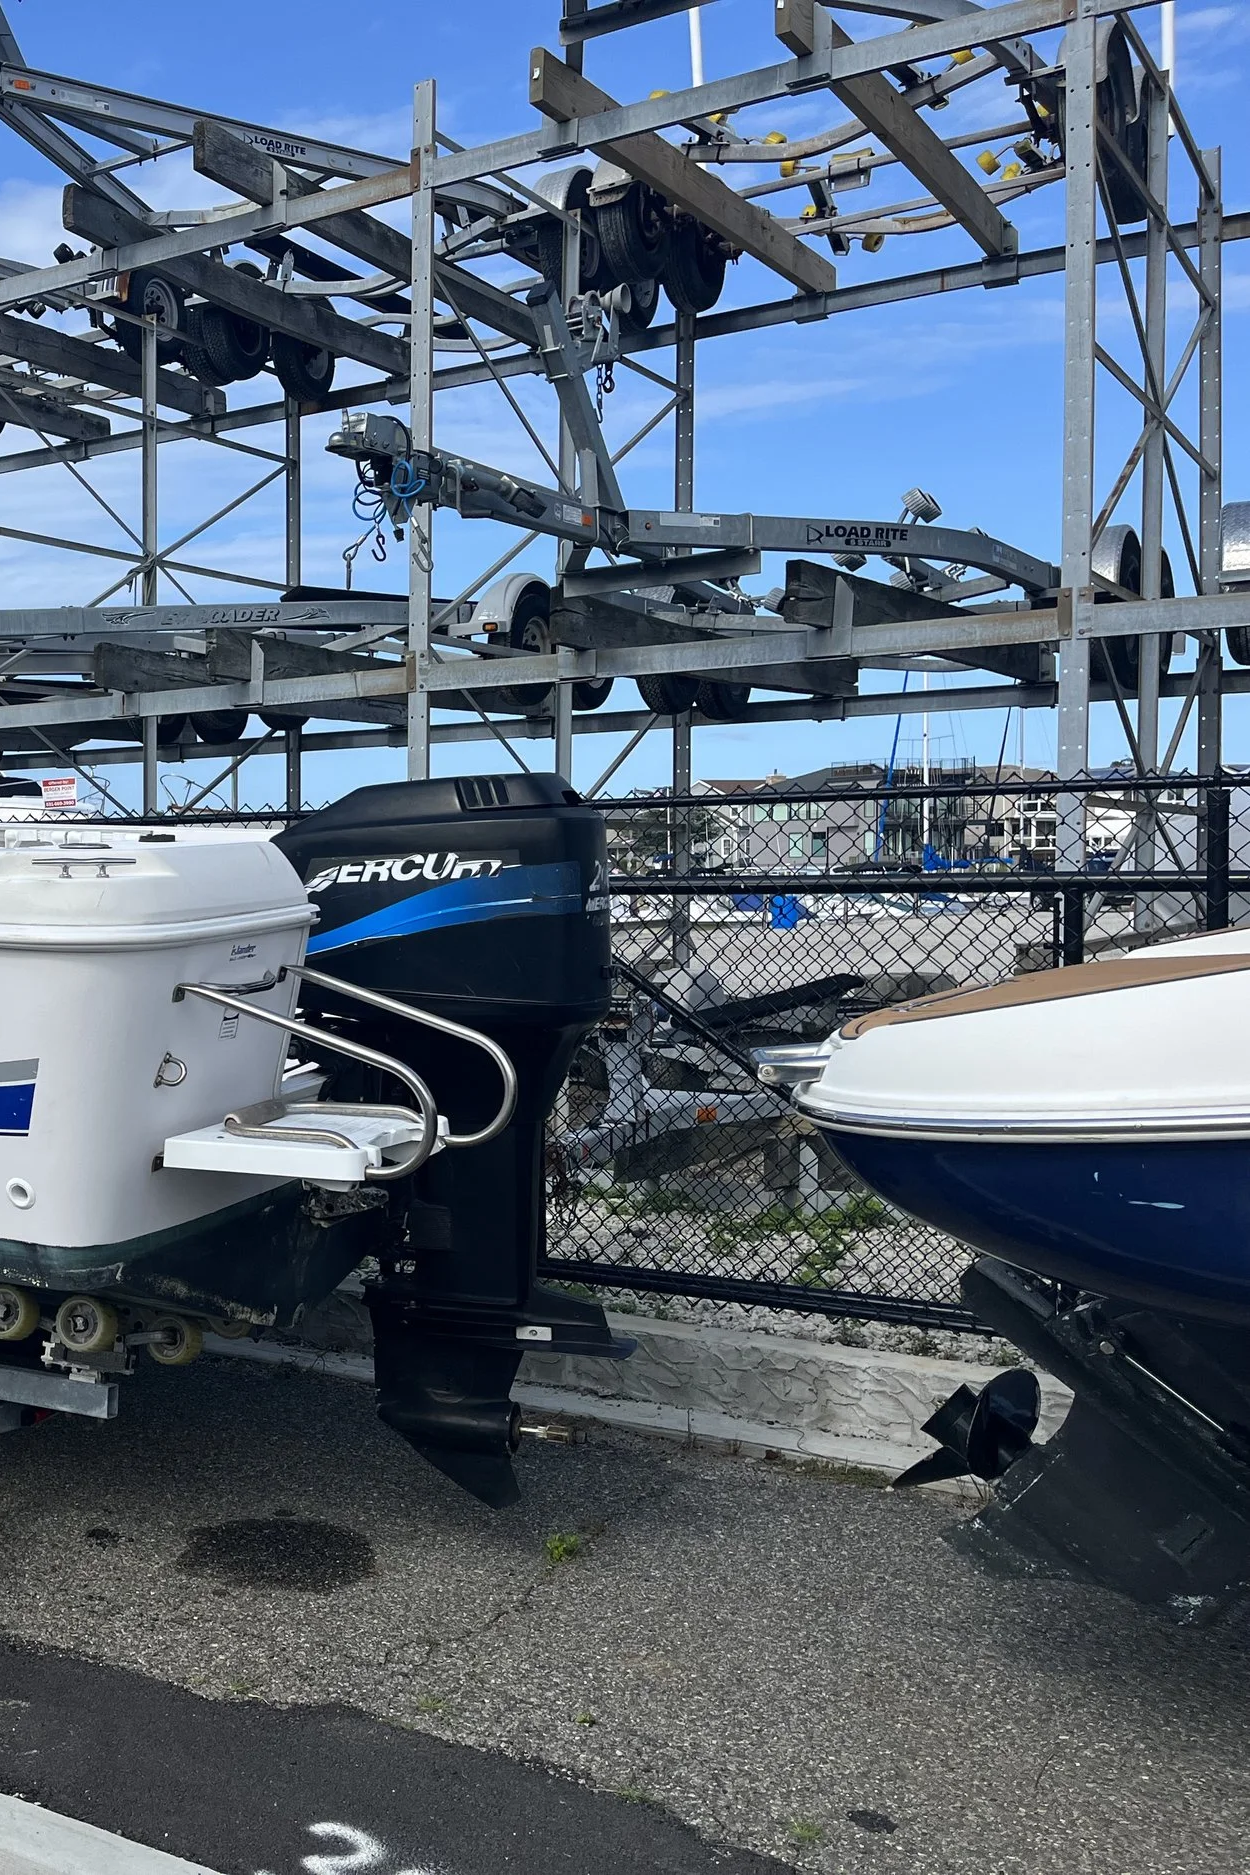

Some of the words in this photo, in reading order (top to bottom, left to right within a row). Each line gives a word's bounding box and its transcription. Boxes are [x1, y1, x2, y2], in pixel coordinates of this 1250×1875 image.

[254, 135, 282, 149] LOAD
[284, 143, 306, 155] RITE
[825, 525, 871, 538] LOAD
[875, 527, 908, 541] RITE
